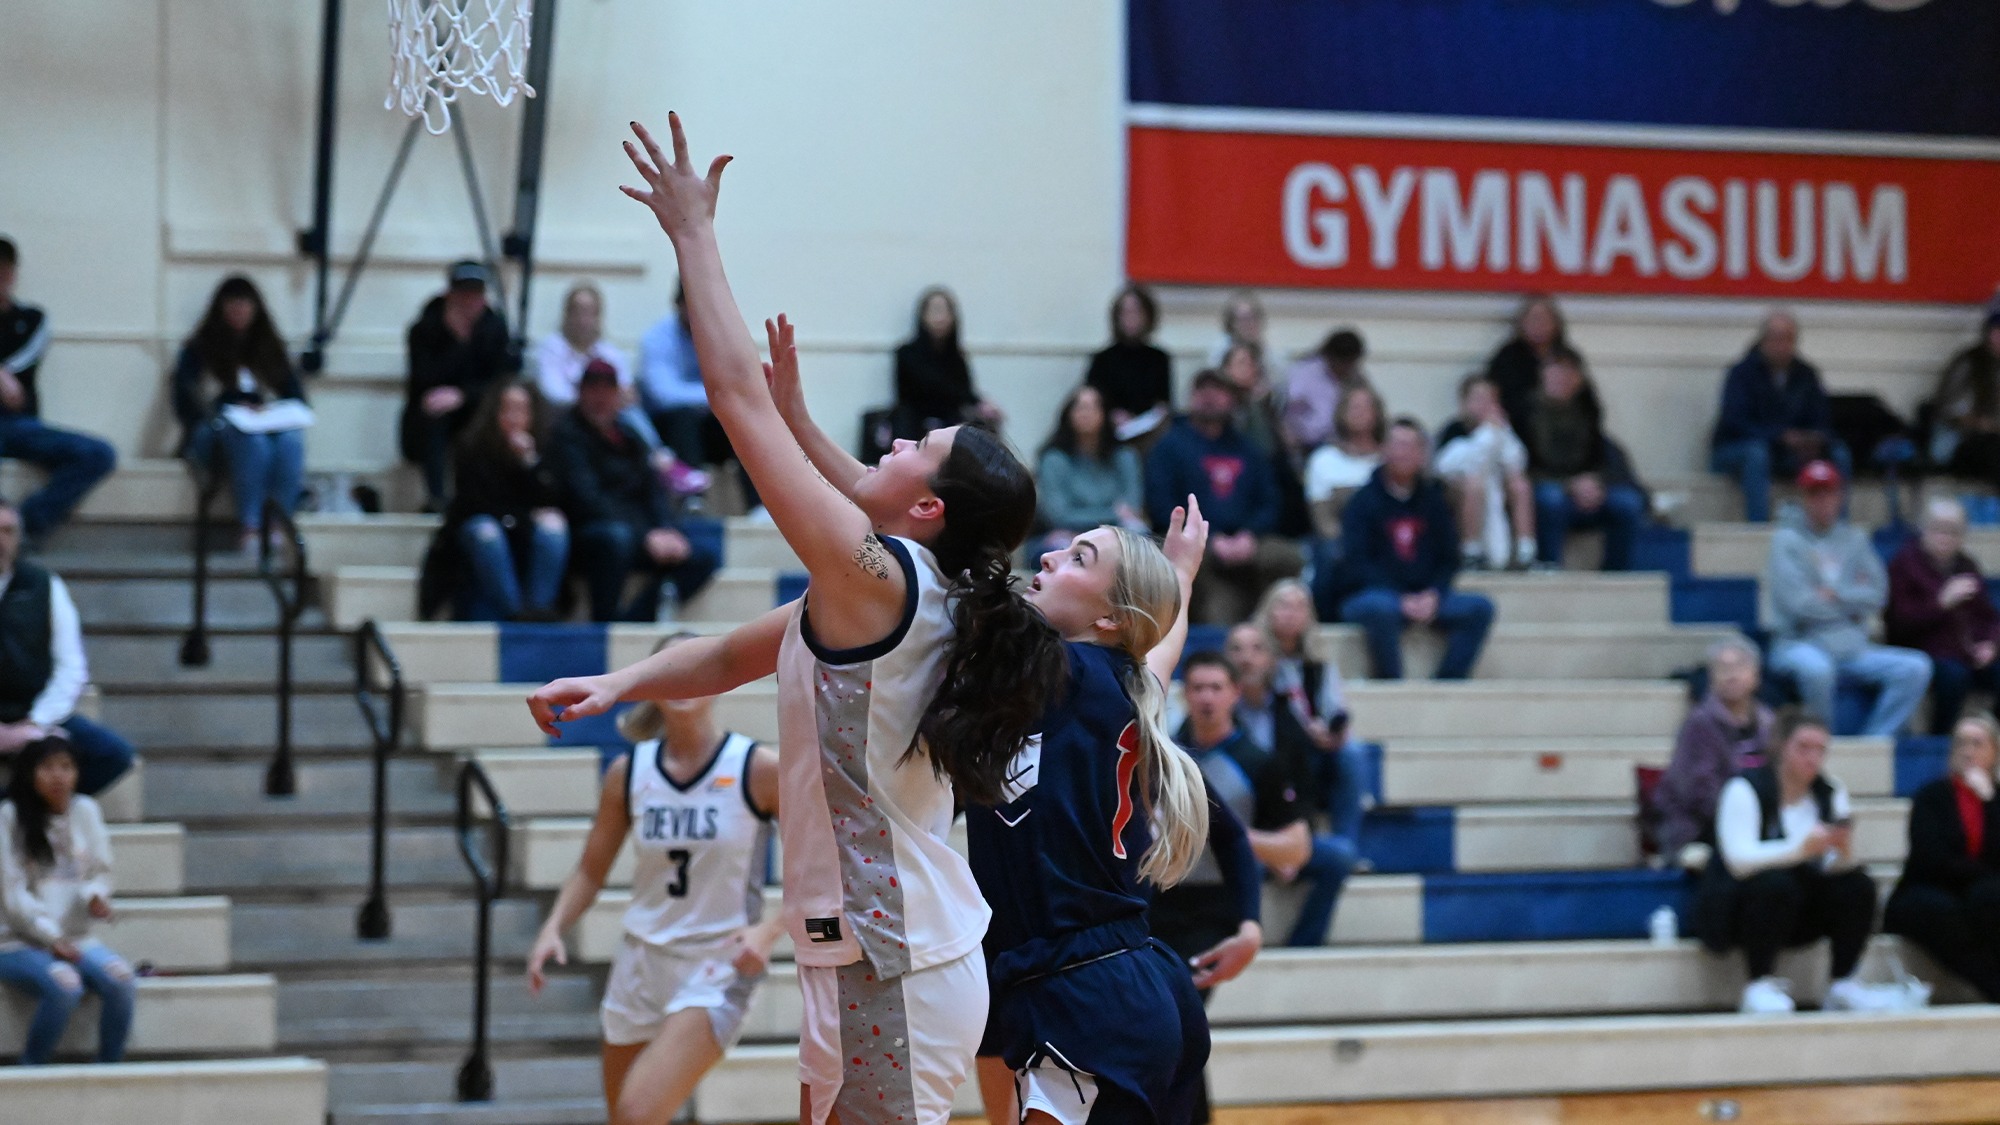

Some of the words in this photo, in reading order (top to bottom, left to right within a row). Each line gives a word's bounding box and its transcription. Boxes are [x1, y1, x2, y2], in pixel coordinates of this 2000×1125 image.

[1280, 160, 1909, 284] GYMNASIUM
[643, 805, 719, 841] DEVILS
[667, 849, 690, 897] 3
